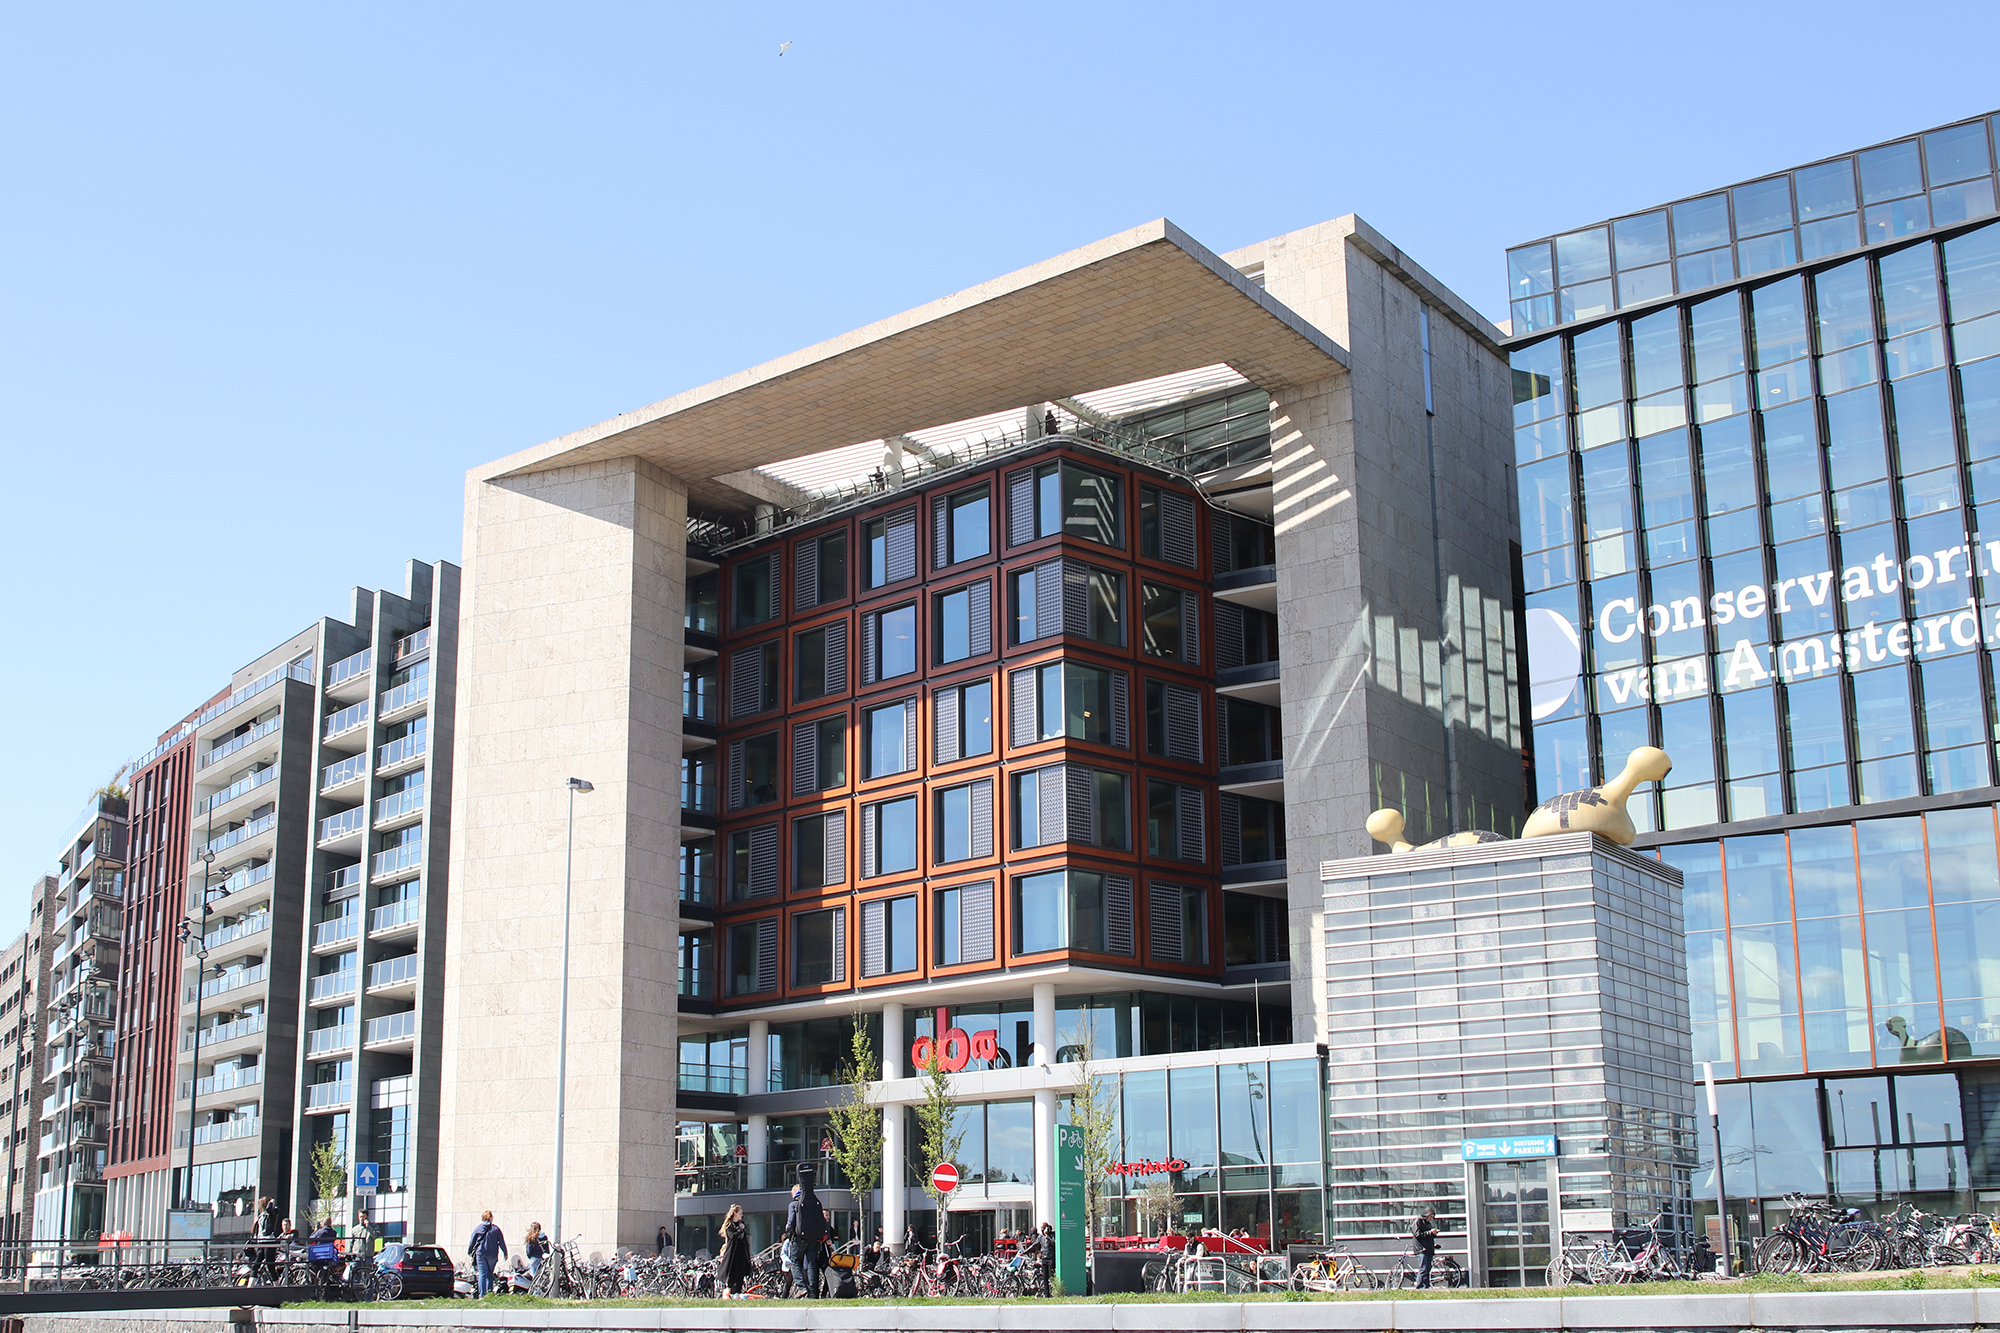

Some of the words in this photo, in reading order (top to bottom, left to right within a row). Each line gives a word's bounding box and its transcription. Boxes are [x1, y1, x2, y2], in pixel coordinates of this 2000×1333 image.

[1604, 656, 1708, 704] van
[1723, 597, 2000, 689] Amsterd
[911, 1007, 997, 1073] oba
[1060, 1128, 1068, 1147] P
[1477, 1143, 1497, 1151] ingang
[1466, 1145, 1475, 1157] P
[1513, 1147, 1545, 1155] PARKING
[1104, 1157, 1184, 1177] VAPIANO
